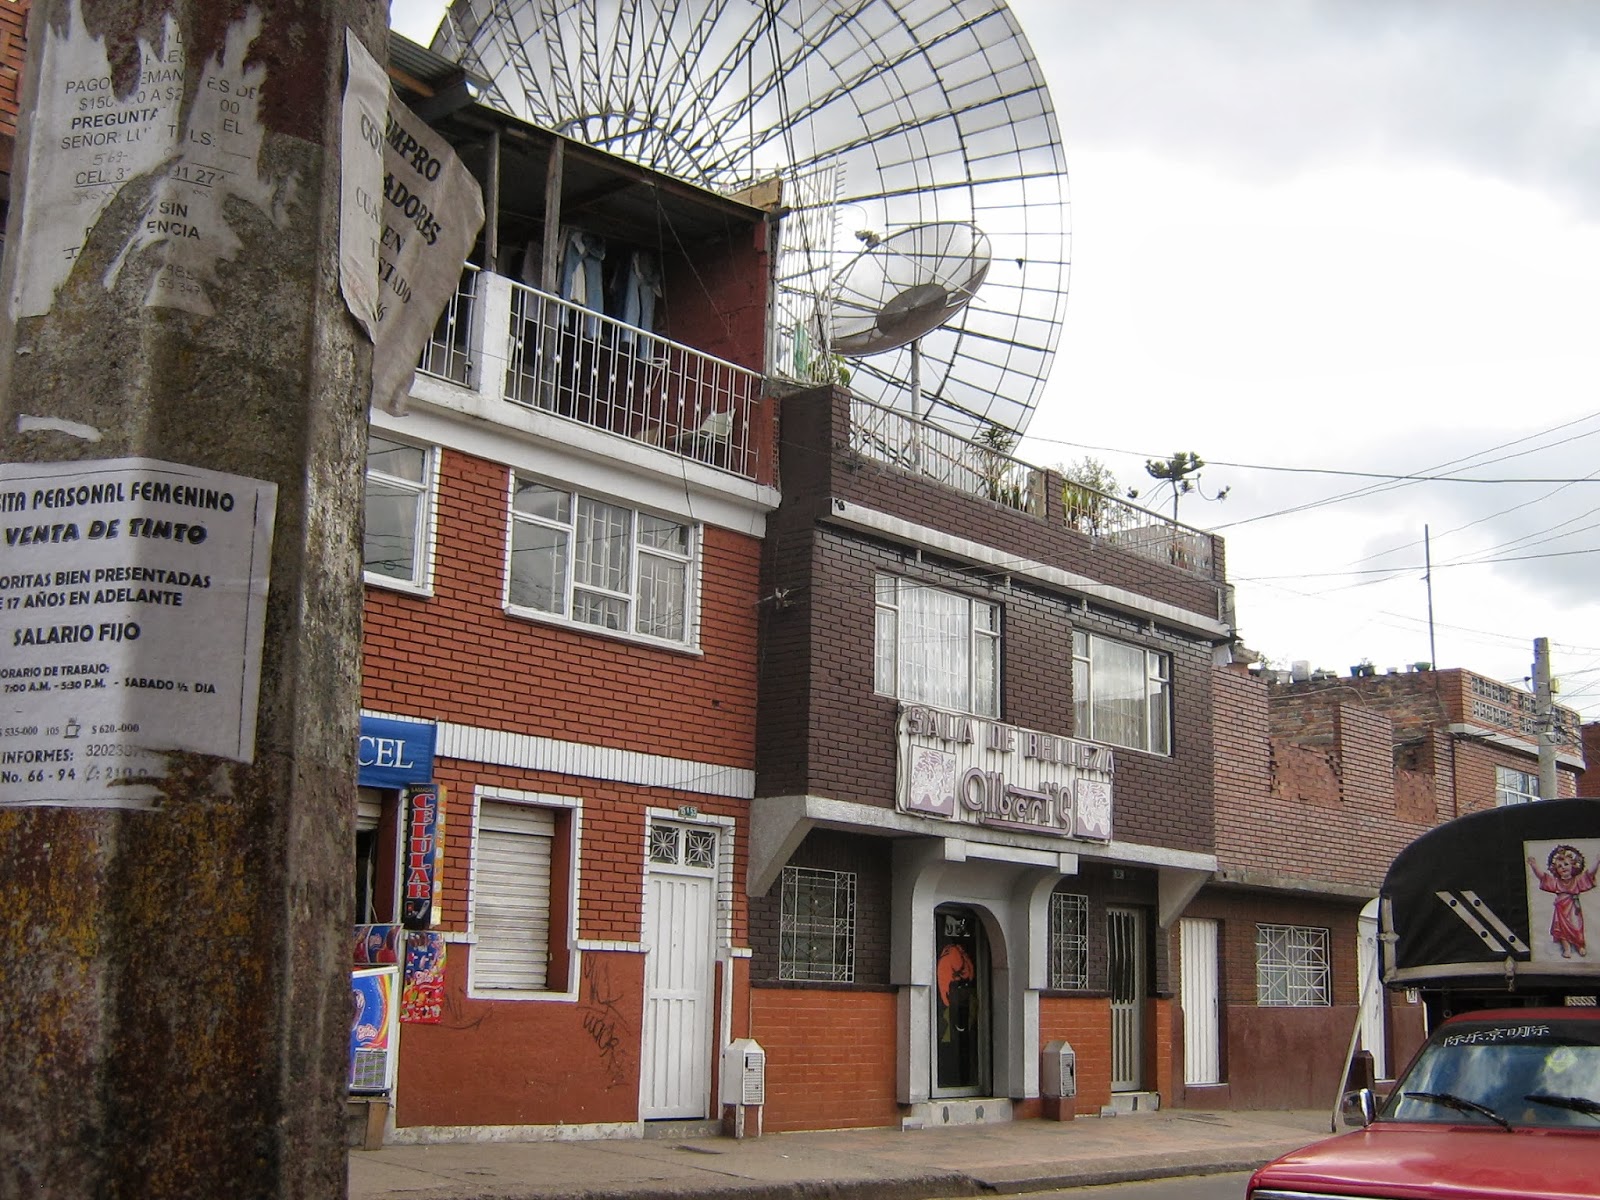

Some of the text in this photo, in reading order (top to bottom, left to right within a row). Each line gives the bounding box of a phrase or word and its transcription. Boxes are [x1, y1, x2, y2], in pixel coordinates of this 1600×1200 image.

[65, 77, 111, 94] PAGO
[158, 201, 189, 218] SIN
[32, 483, 126, 511] PERSONAL
[131, 481, 236, 513] FEMENINO
[6, 517, 208, 547] VENTA DE TINTO
[55, 569, 91, 586] BIEN
[94, 566, 212, 588] PRESENTADAS
[7, 597, 20, 609] 17
[24, 591, 65, 608] AÑOS
[69, 590, 90, 606] EN
[94, 587, 183, 607] ADELANTE
[14, 621, 141, 647] SALARIO FIJO
[0, 663, 110, 679] ORARIO DE TRABAJO:
[124, 677, 174, 690] SABADO
[194, 682, 216, 694] DIA
[908, 705, 1115, 773] SALA DE BELLEZA
[2, 749, 74, 764] INFORMES:
[1, 770, 22, 783] No.
[27, 769, 44, 782] 66
[58, 767, 76, 781] 94
[406, 793, 436, 899] CELULAR
